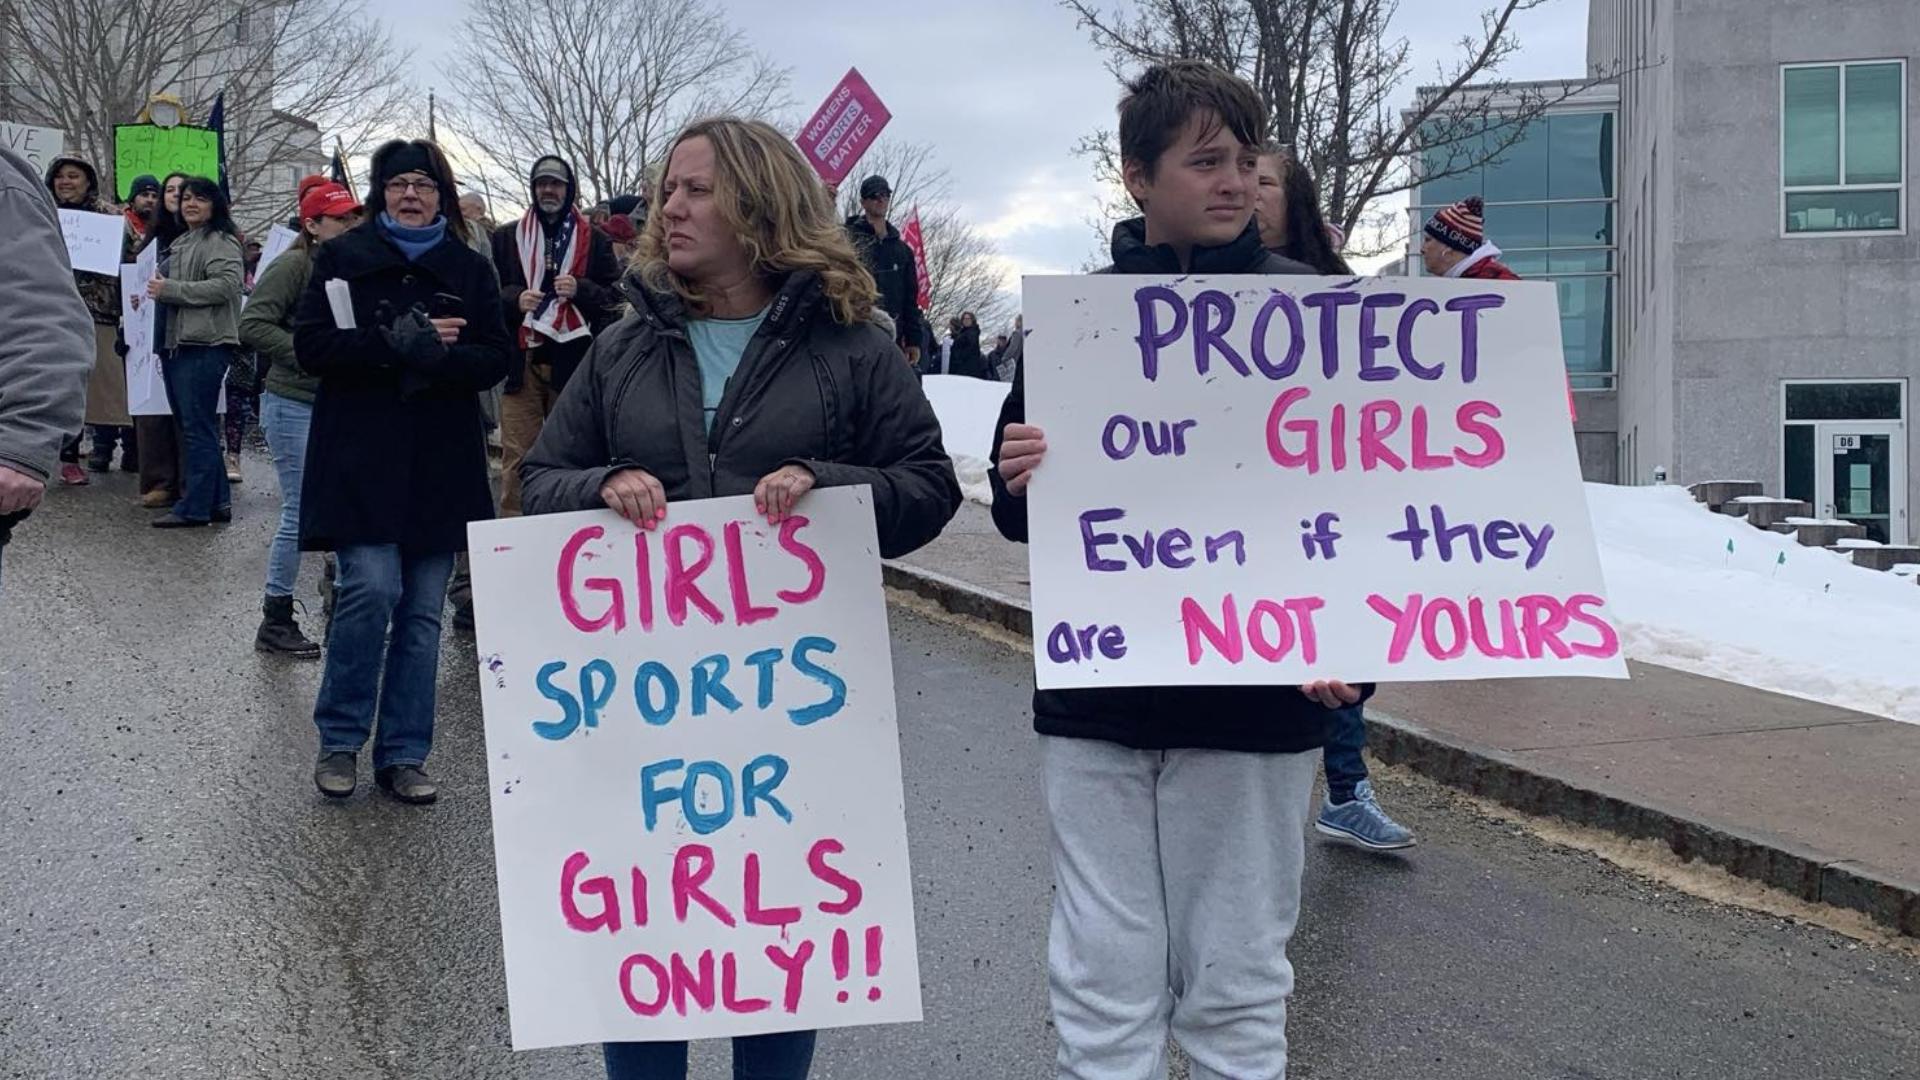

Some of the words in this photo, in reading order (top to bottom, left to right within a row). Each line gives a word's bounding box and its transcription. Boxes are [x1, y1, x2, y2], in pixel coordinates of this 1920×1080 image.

[0, 125, 41, 152] VE
[807, 86, 850, 142] WOMENS
[819, 105, 859, 155] SPORTS
[828, 114, 872, 171] MATTER
[1134, 286, 1506, 383] PROTECT
[1101, 413, 1197, 460] our
[1265, 386, 1505, 474] GIRLS
[556, 514, 827, 634] GIRLS
[1079, 507, 1246, 572] Even
[1300, 511, 1342, 560] if
[1387, 504, 1555, 570] they
[1046, 621, 1128, 664] are
[1180, 593, 1326, 666] NOT
[1366, 593, 1619, 664] YOURS
[531, 635, 848, 741] SPORTS
[640, 753, 793, 835] FOR
[559, 838, 863, 936] GIRLS
[618, 925, 884, 1017] ONLY!!
